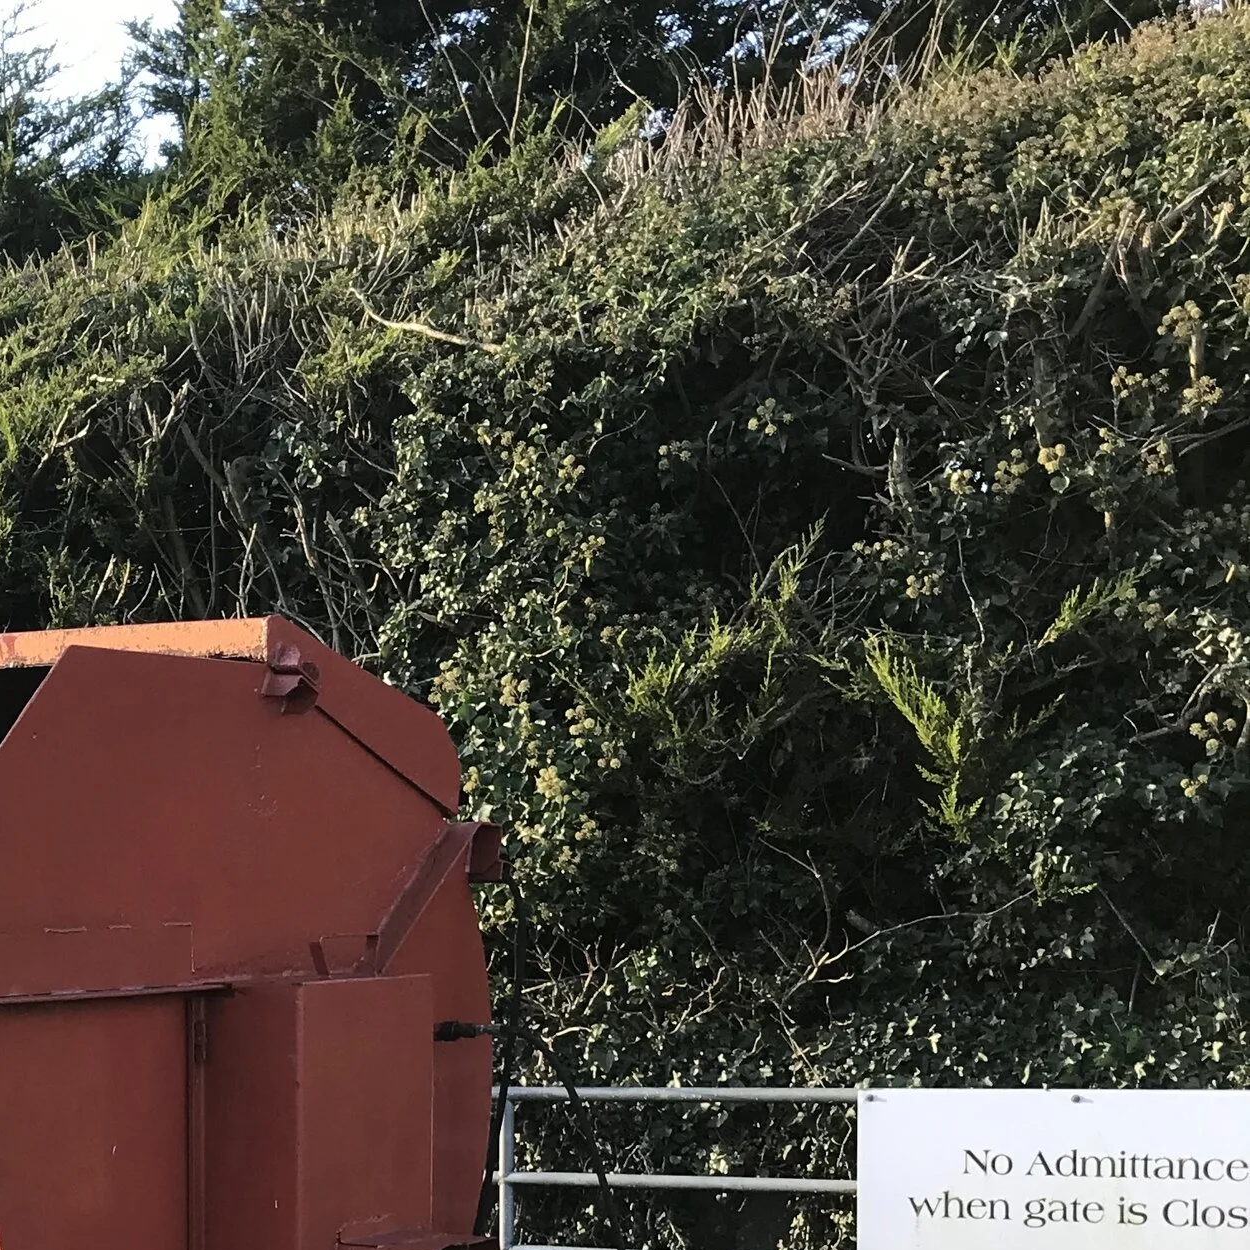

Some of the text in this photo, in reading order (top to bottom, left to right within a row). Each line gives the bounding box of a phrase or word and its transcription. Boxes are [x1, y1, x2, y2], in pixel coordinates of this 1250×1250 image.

[963, 1149, 1249, 1181] No Admittance
[908, 1190, 1011, 1220] when
[1023, 1198, 1104, 1228] gate
[1117, 1196, 1148, 1225] is
